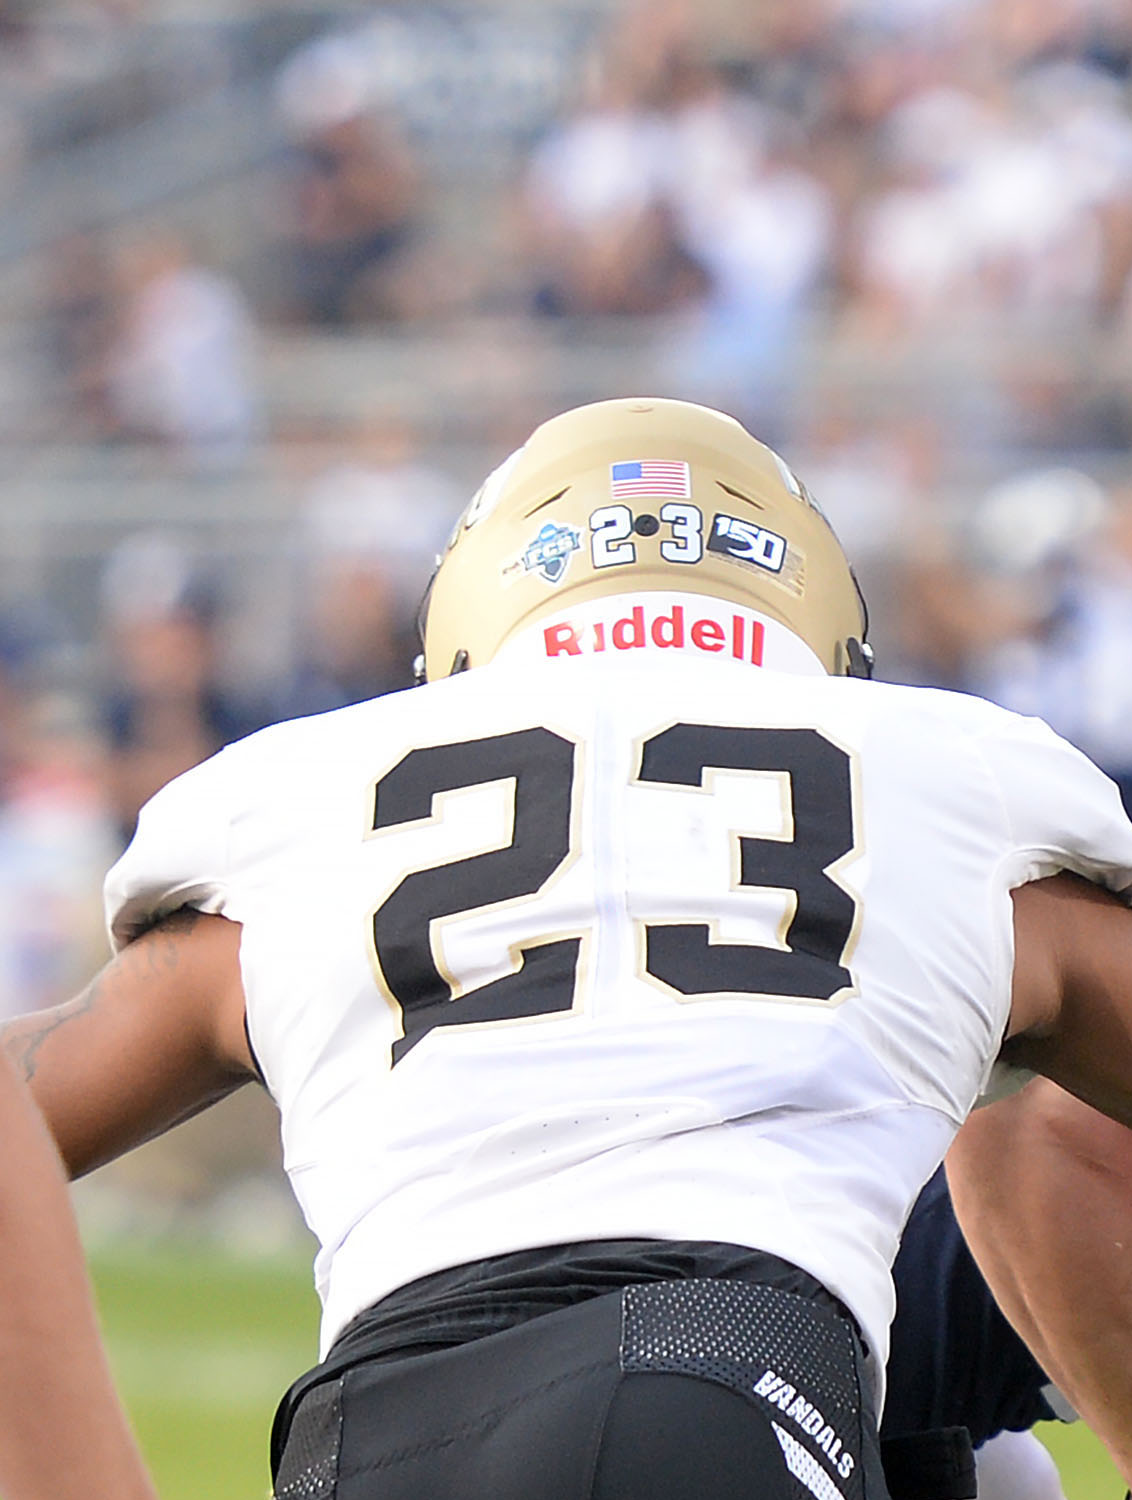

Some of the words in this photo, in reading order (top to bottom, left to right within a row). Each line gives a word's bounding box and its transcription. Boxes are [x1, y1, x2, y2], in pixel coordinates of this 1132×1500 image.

[714, 515, 785, 571] 150
[362, 718, 867, 1071] 23
[753, 1370, 855, 1478] VANDALS
